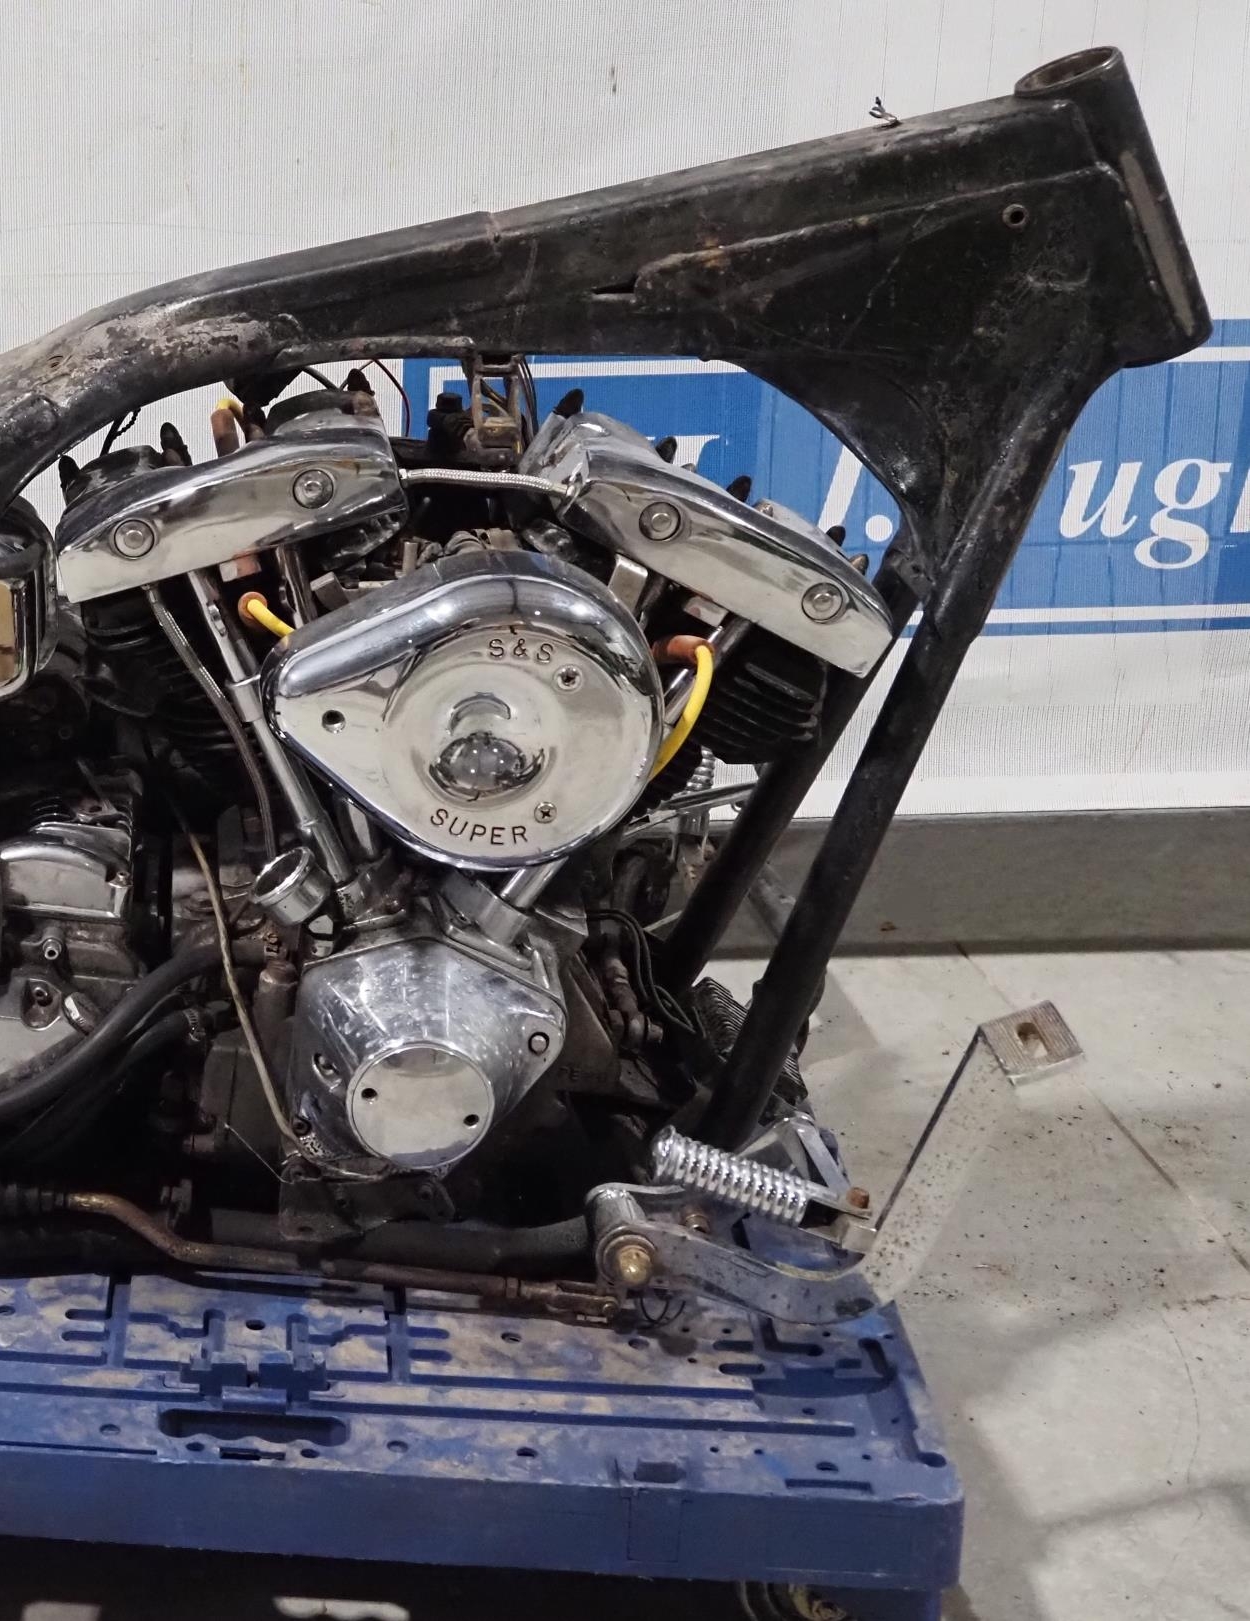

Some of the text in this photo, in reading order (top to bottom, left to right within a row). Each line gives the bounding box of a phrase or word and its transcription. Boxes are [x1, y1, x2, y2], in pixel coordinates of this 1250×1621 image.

[1060, 459, 1250, 569] ug
[488, 638, 554, 662] S&S
[430, 808, 528, 845] SUPER
